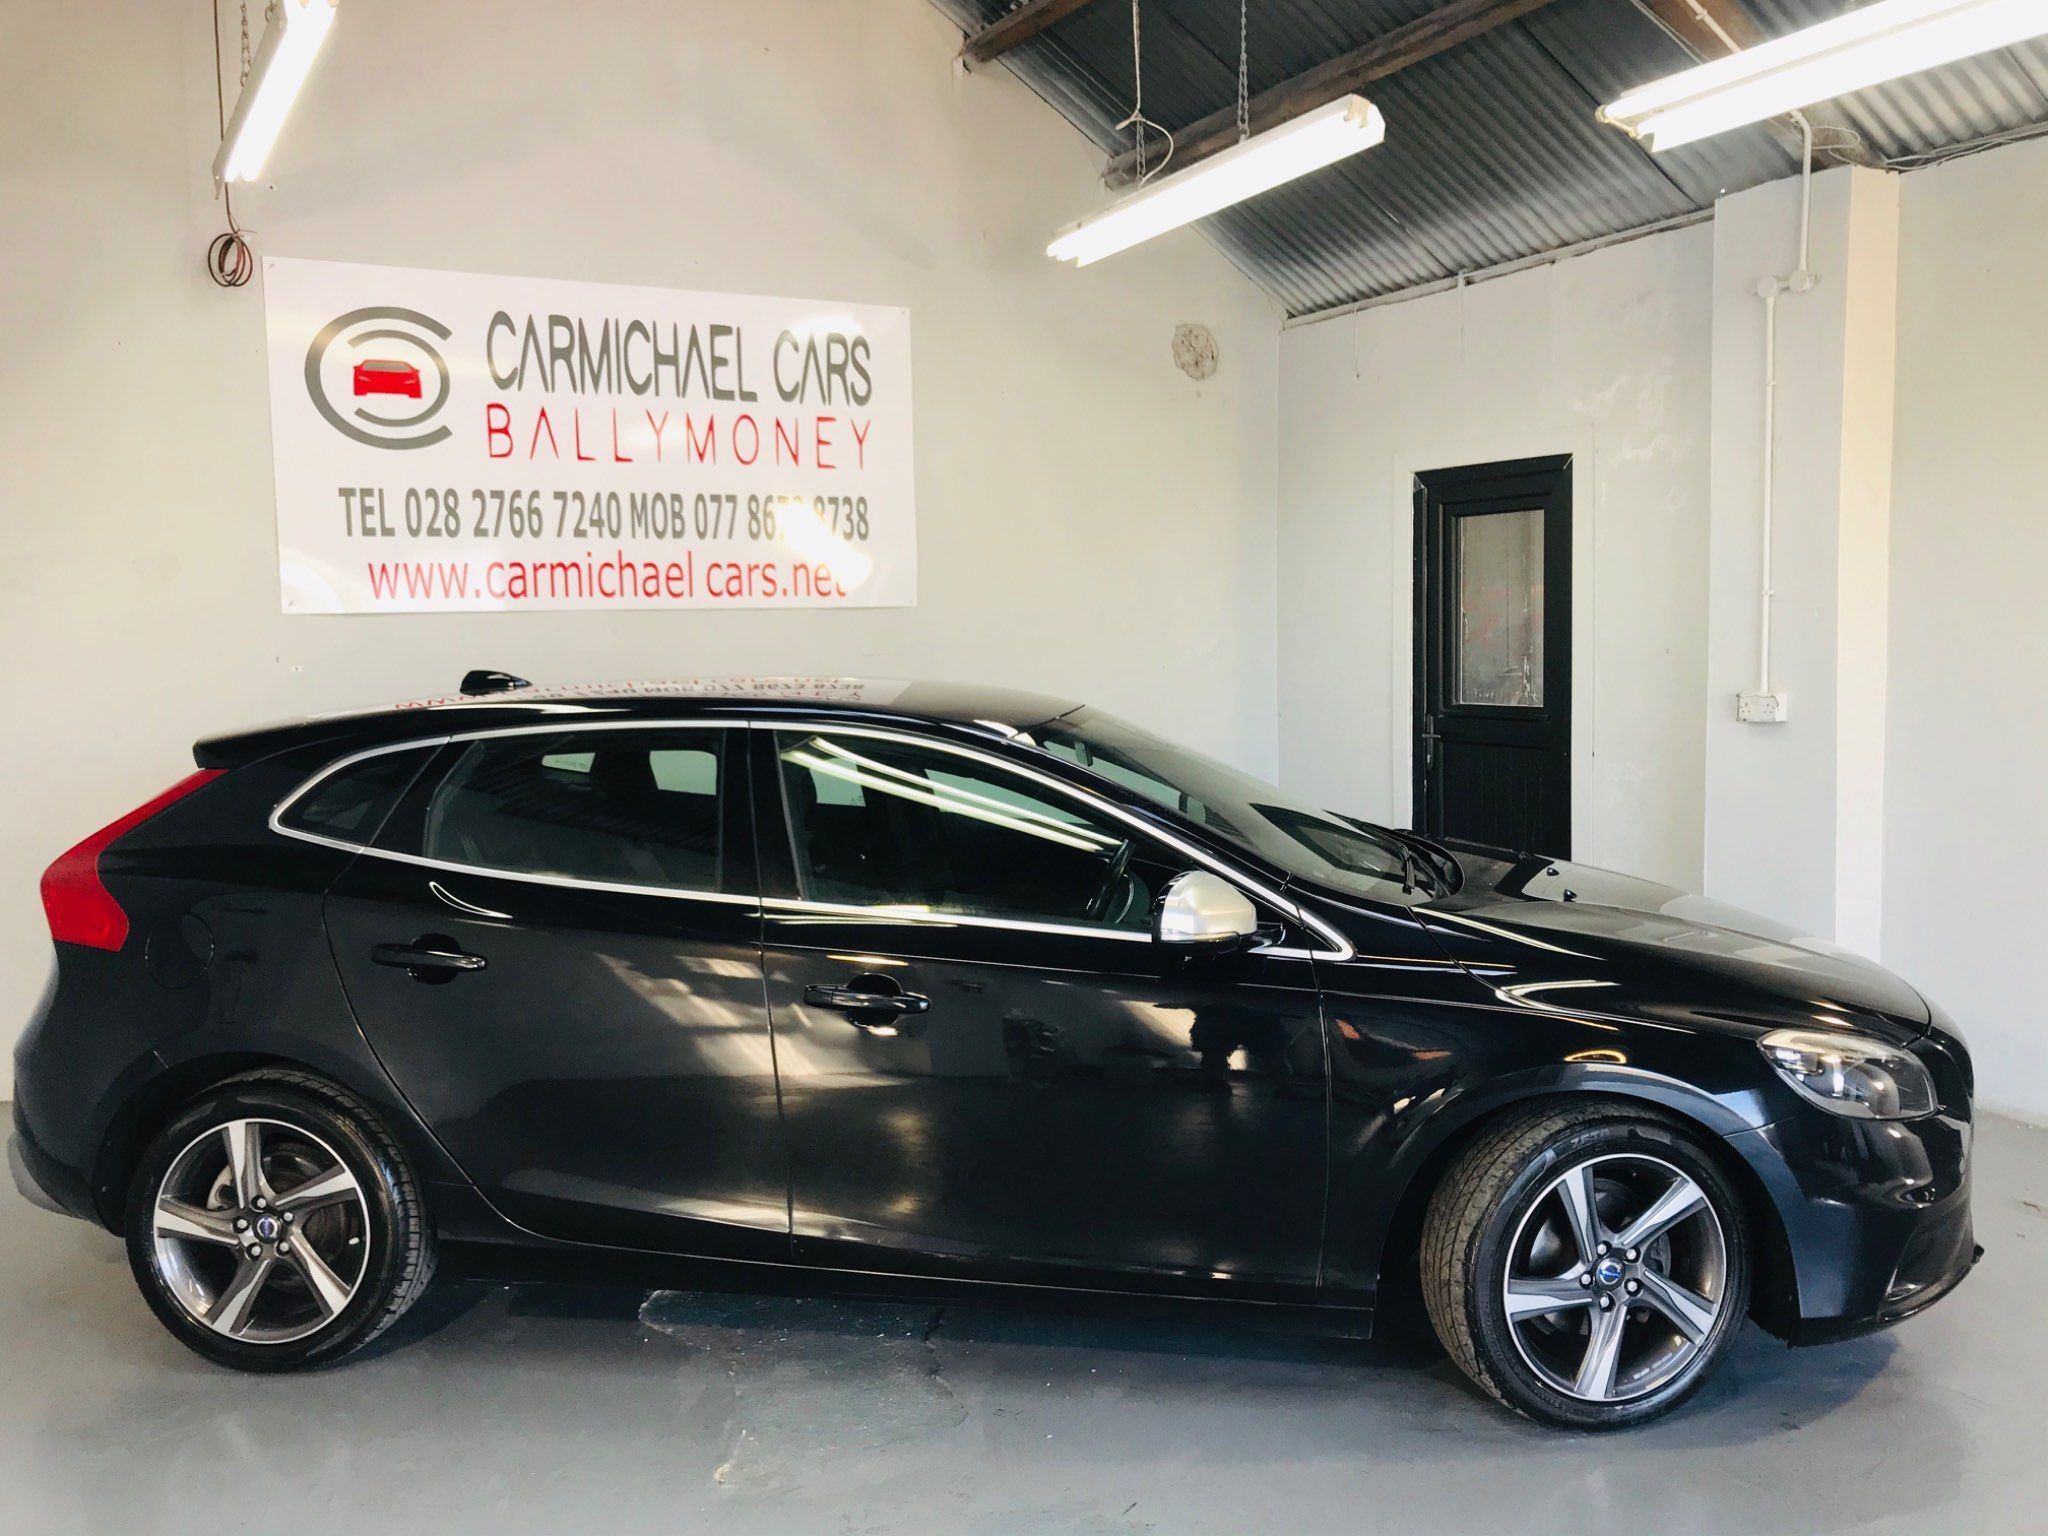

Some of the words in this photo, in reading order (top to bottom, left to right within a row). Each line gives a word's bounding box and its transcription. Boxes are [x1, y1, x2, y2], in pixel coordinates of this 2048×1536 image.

[486, 310, 759, 403] CARMICHAEL
[773, 329, 873, 408] CARS
[486, 402, 872, 471] BALLYMONEY
[338, 487, 397, 539] TEL
[405, 488, 462, 540] 028
[472, 489, 544, 540] 2766
[554, 491, 623, 541] 7240
[630, 493, 687, 541] MOB
[694, 493, 739, 541] 077
[748, 495, 804, 542] 86
[368, 550, 695, 601] www.carmichael
